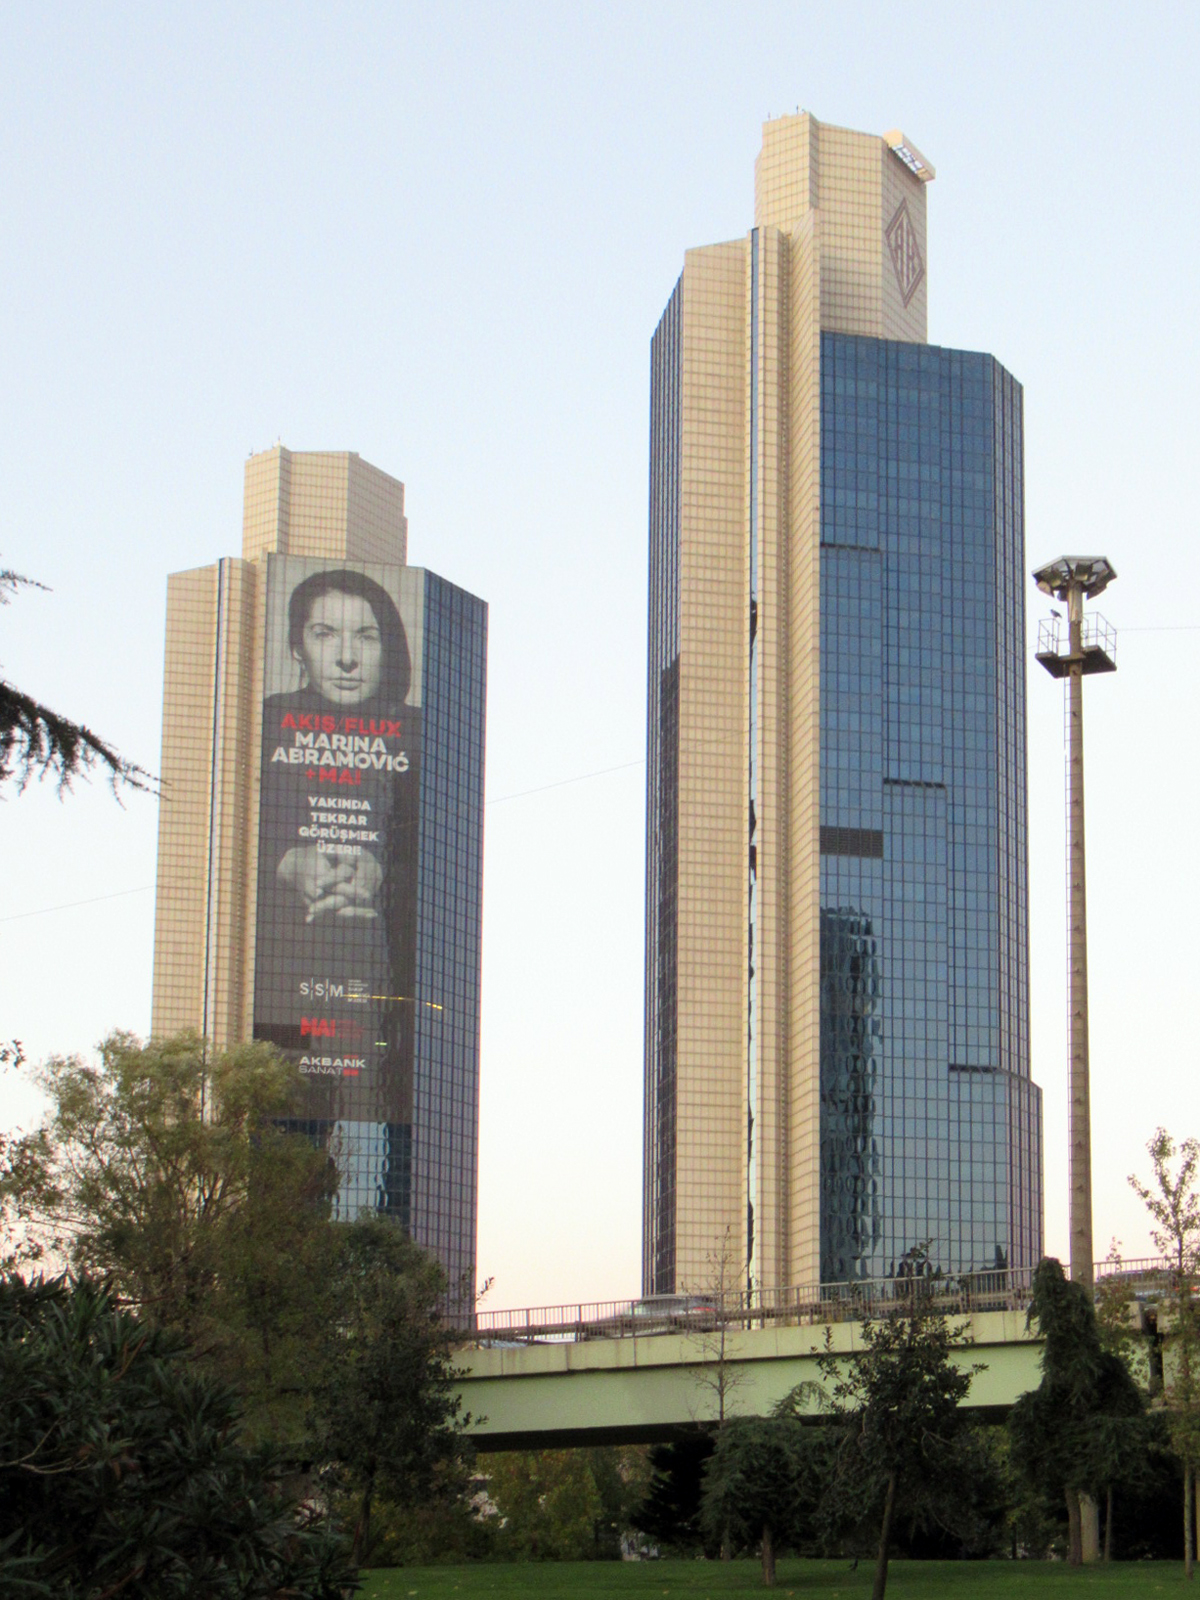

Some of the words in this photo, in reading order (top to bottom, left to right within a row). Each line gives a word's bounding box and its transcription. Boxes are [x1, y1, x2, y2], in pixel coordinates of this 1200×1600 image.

[295, 731, 387, 753] MARINA
[271, 747, 410, 772] ABRAMOVIĆ
[308, 796, 371, 811] YAKINDA
[310, 812, 368, 826] TEKRAR
[298, 825, 379, 843] GÖRÜŞMEK
[316, 841, 362, 856] ÜZERE
[299, 1056, 367, 1068] AKBANK
[299, 1065, 343, 1075] SANAT
